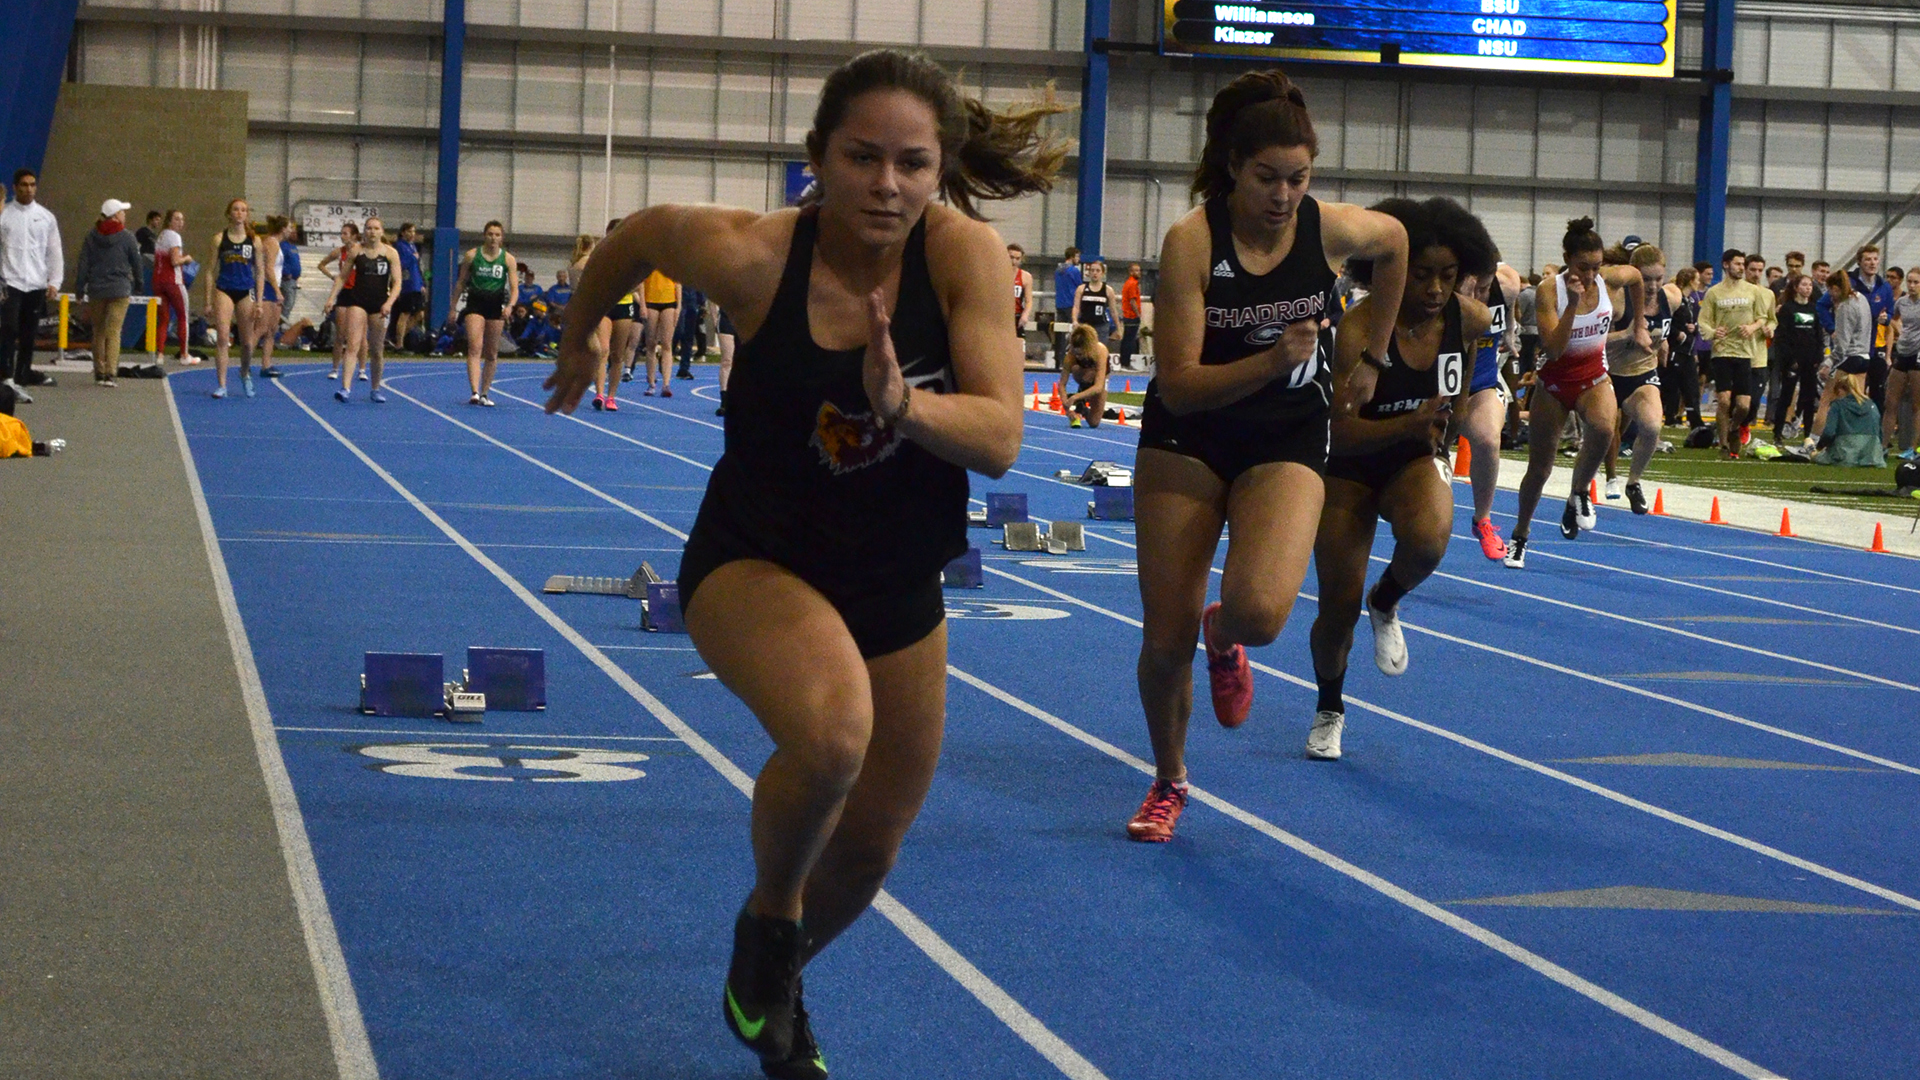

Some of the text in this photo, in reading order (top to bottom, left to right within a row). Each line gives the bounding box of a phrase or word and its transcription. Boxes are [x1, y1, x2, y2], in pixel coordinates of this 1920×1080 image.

[1480, 0, 1519, 14] BSU
[1214, 5, 1527, 35] Williamson CHAD
[1214, 26, 1518, 56] Kinzer NSU
[328, 206, 377, 217] 30 28
[305, 218, 321, 227] 28
[308, 233, 323, 243] 54
[1213, 270, 1235, 278] adidas
[1204, 290, 1325, 329] CHADRON
[1492, 307, 1503, 330] 4
[1600, 316, 1610, 335] 3
[1663, 320, 1671, 339] 2
[1444, 355, 1459, 394] 6
[359, 743, 651, 782] 8
